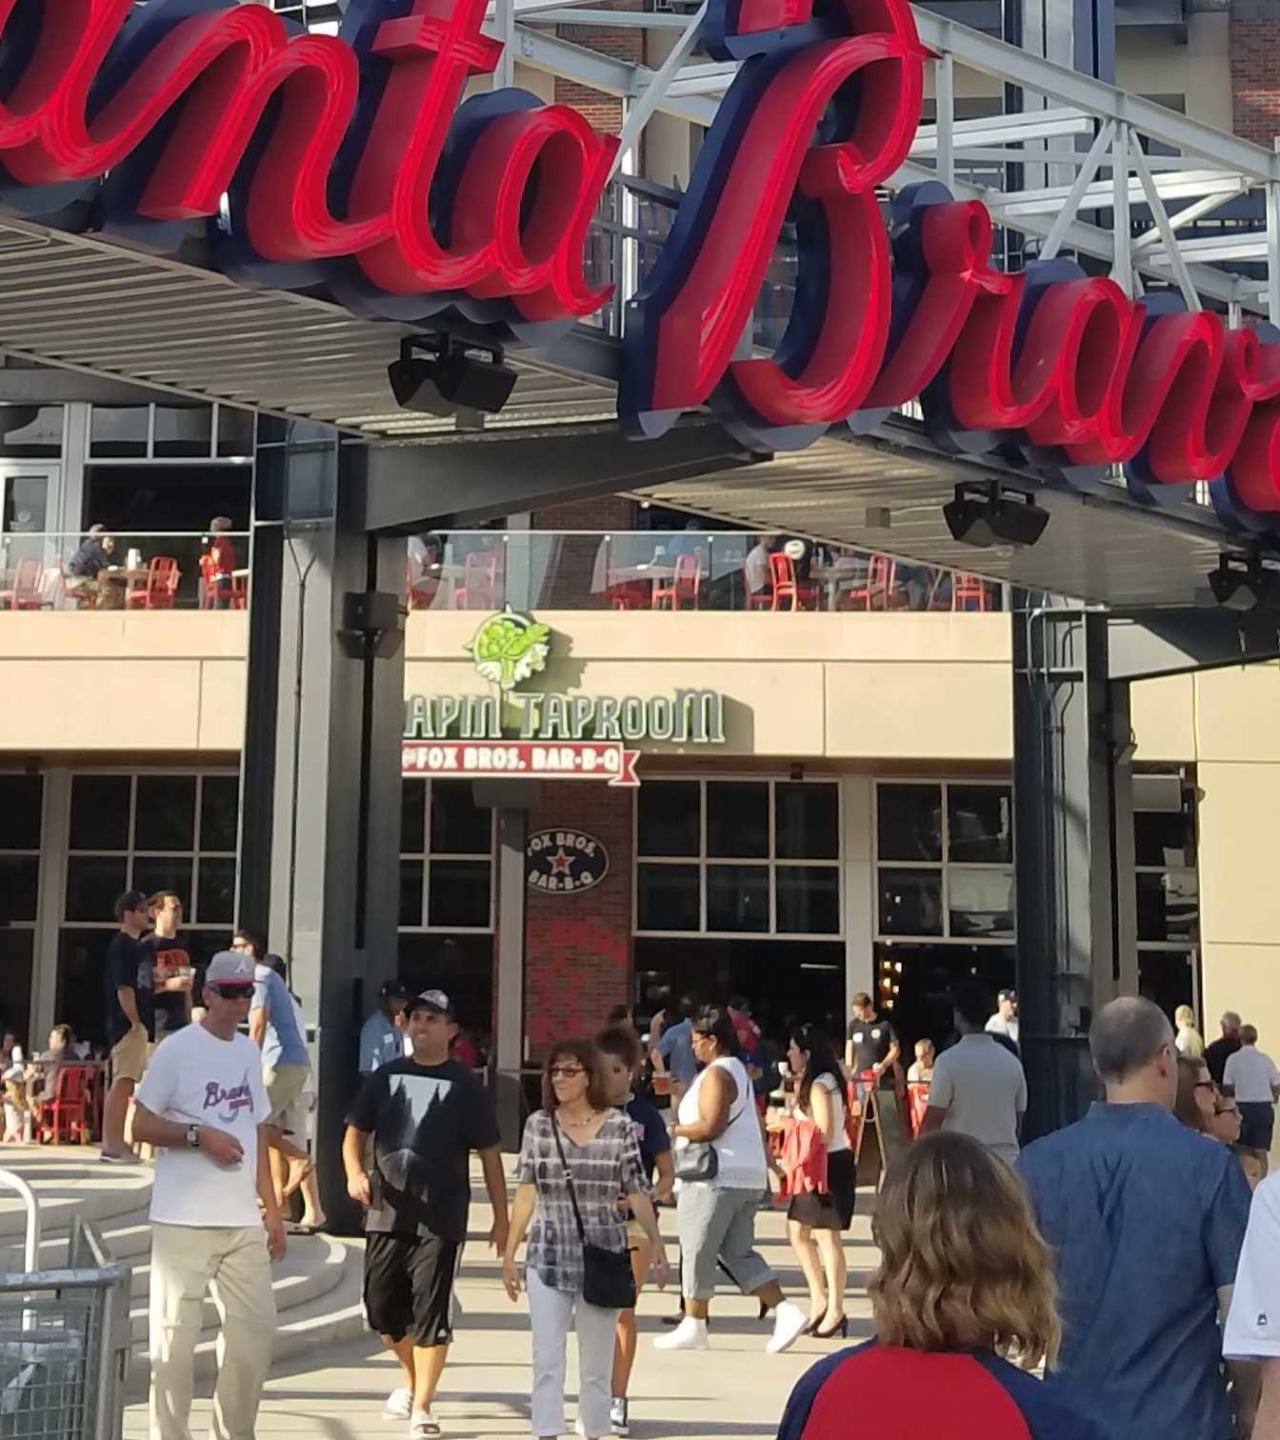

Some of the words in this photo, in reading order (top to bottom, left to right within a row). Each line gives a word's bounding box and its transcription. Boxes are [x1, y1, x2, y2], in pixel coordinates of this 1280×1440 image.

[515, 687, 726, 744] TAPROOM
[416, 746, 459, 770] FOX
[463, 746, 526, 771] BROS.
[531, 747, 619, 773] BAR-B-Q
